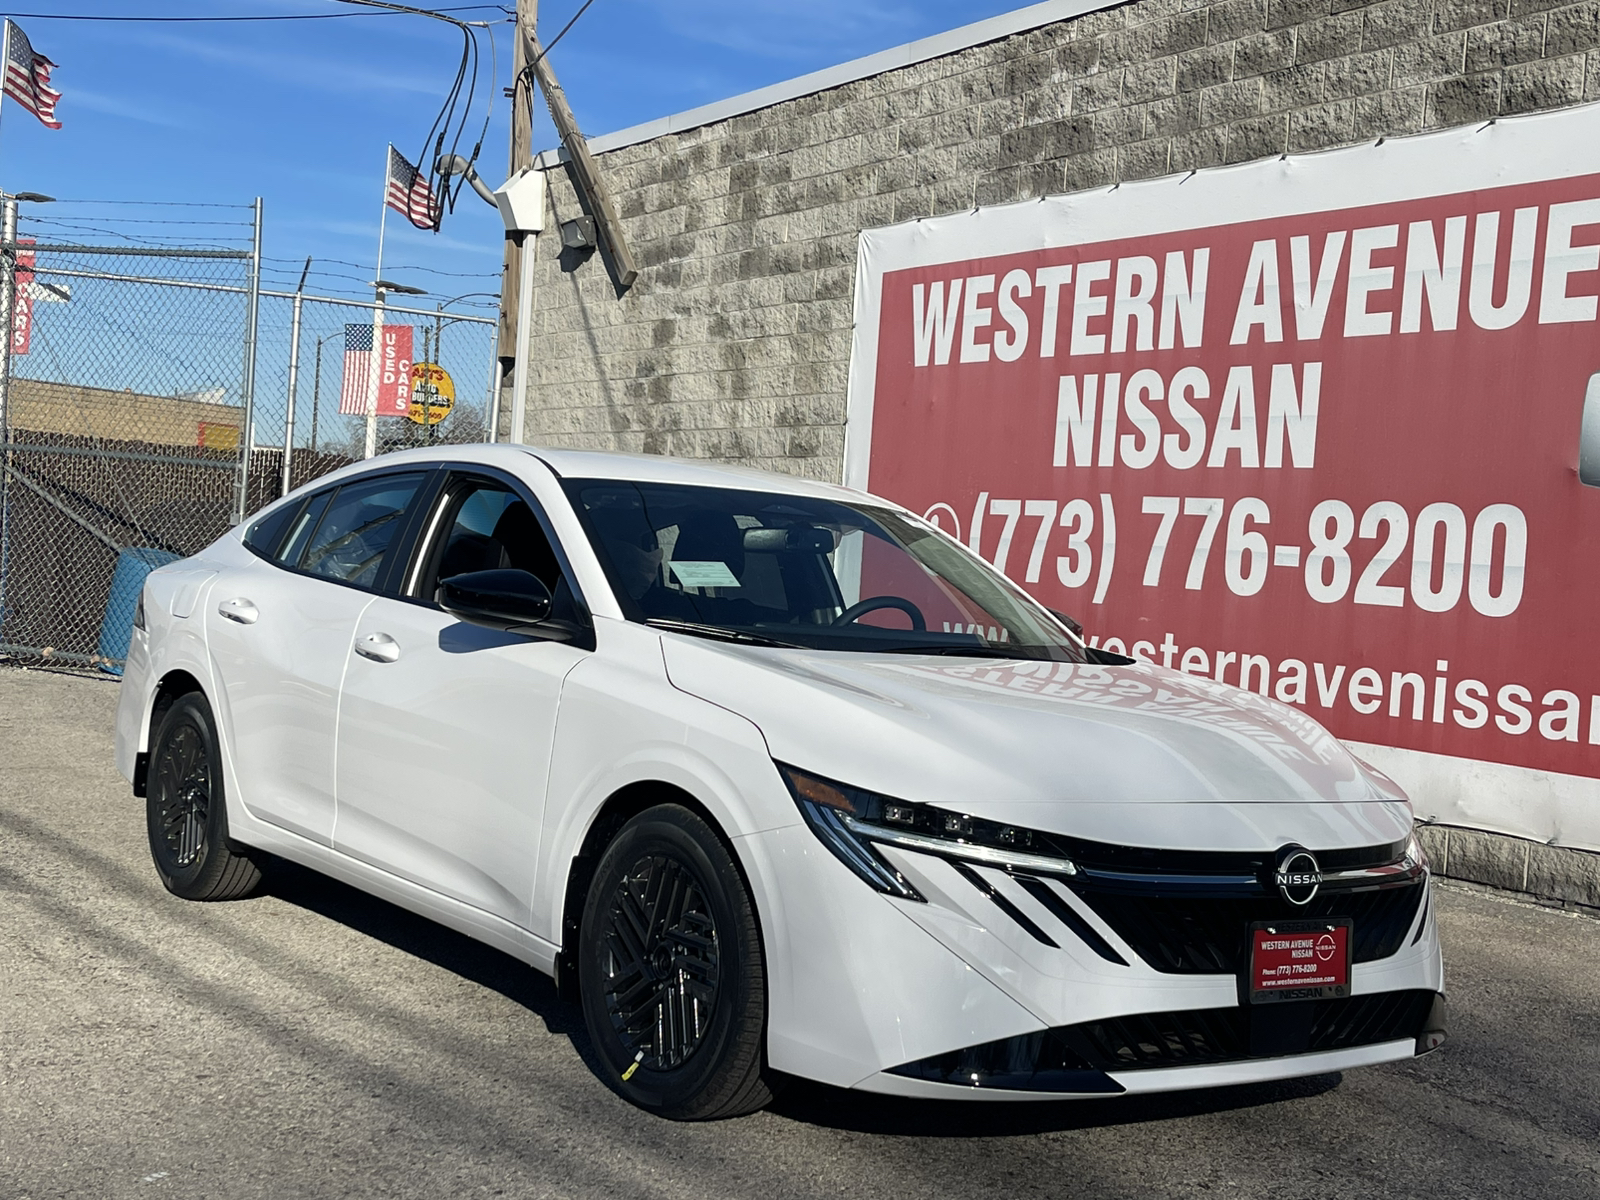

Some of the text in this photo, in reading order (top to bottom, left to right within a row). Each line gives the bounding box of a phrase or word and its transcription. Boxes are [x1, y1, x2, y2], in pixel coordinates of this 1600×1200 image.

[911, 199, 1600, 368] WESTERN AVENUE
[383, 333, 396, 384] USED
[395, 359, 410, 410] CARS
[1052, 361, 1322, 469] NISSAN
[969, 491, 1527, 618] (773) 776-8200
[1277, 873, 1323, 884] NISSAN
[1261, 939, 1314, 950] WESTERN AVENUE
[1291, 949, 1314, 958] NISSAN
[1277, 965, 1291, 976] (773)
[1292, 964, 1317, 973] 776-8200
[1279, 988, 1322, 999] NISSAN
